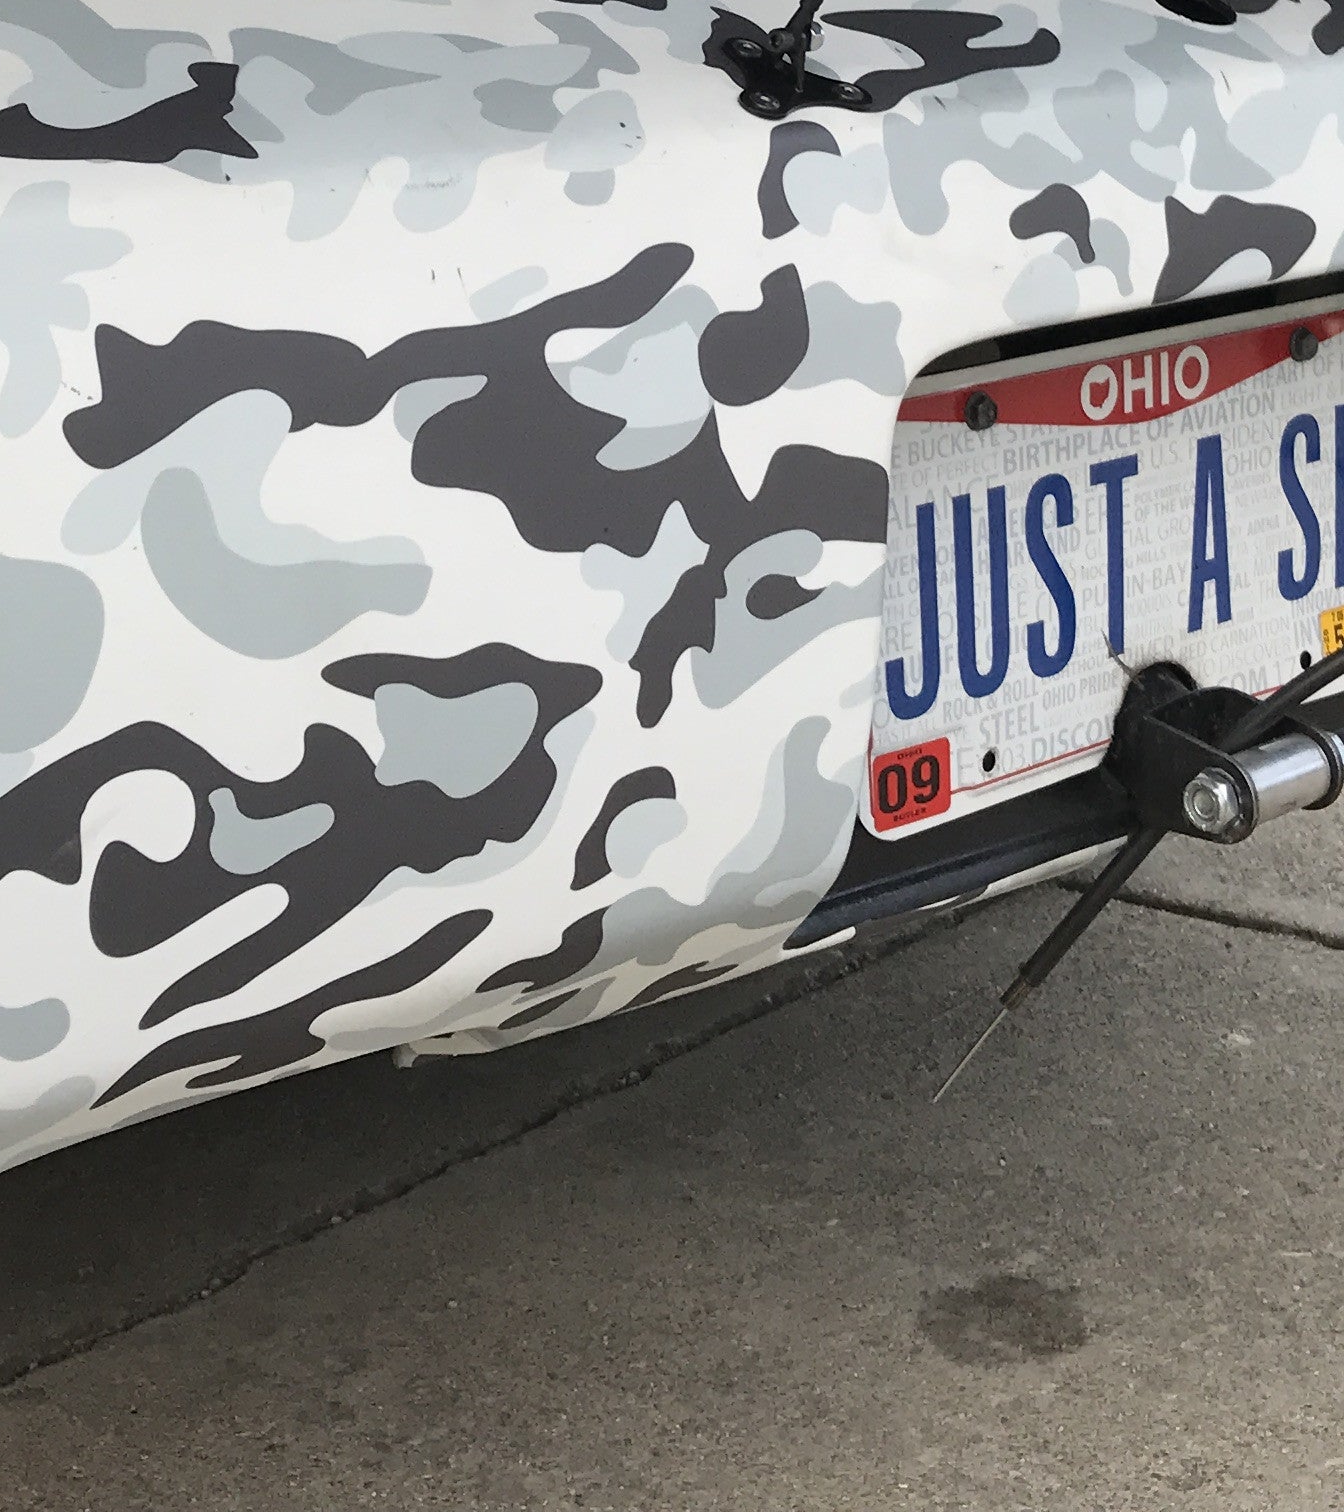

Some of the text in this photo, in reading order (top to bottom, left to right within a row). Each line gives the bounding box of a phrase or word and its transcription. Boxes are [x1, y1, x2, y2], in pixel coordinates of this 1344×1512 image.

[1081, 345, 1209, 420] OHIO
[1003, 390, 1275, 476] BIRTHPLACE OF AVIATION
[885, 455, 1138, 720] JUST
[1187, 435, 1232, 634] A
[979, 701, 1040, 747] STEEL
[877, 754, 940, 814] 09
